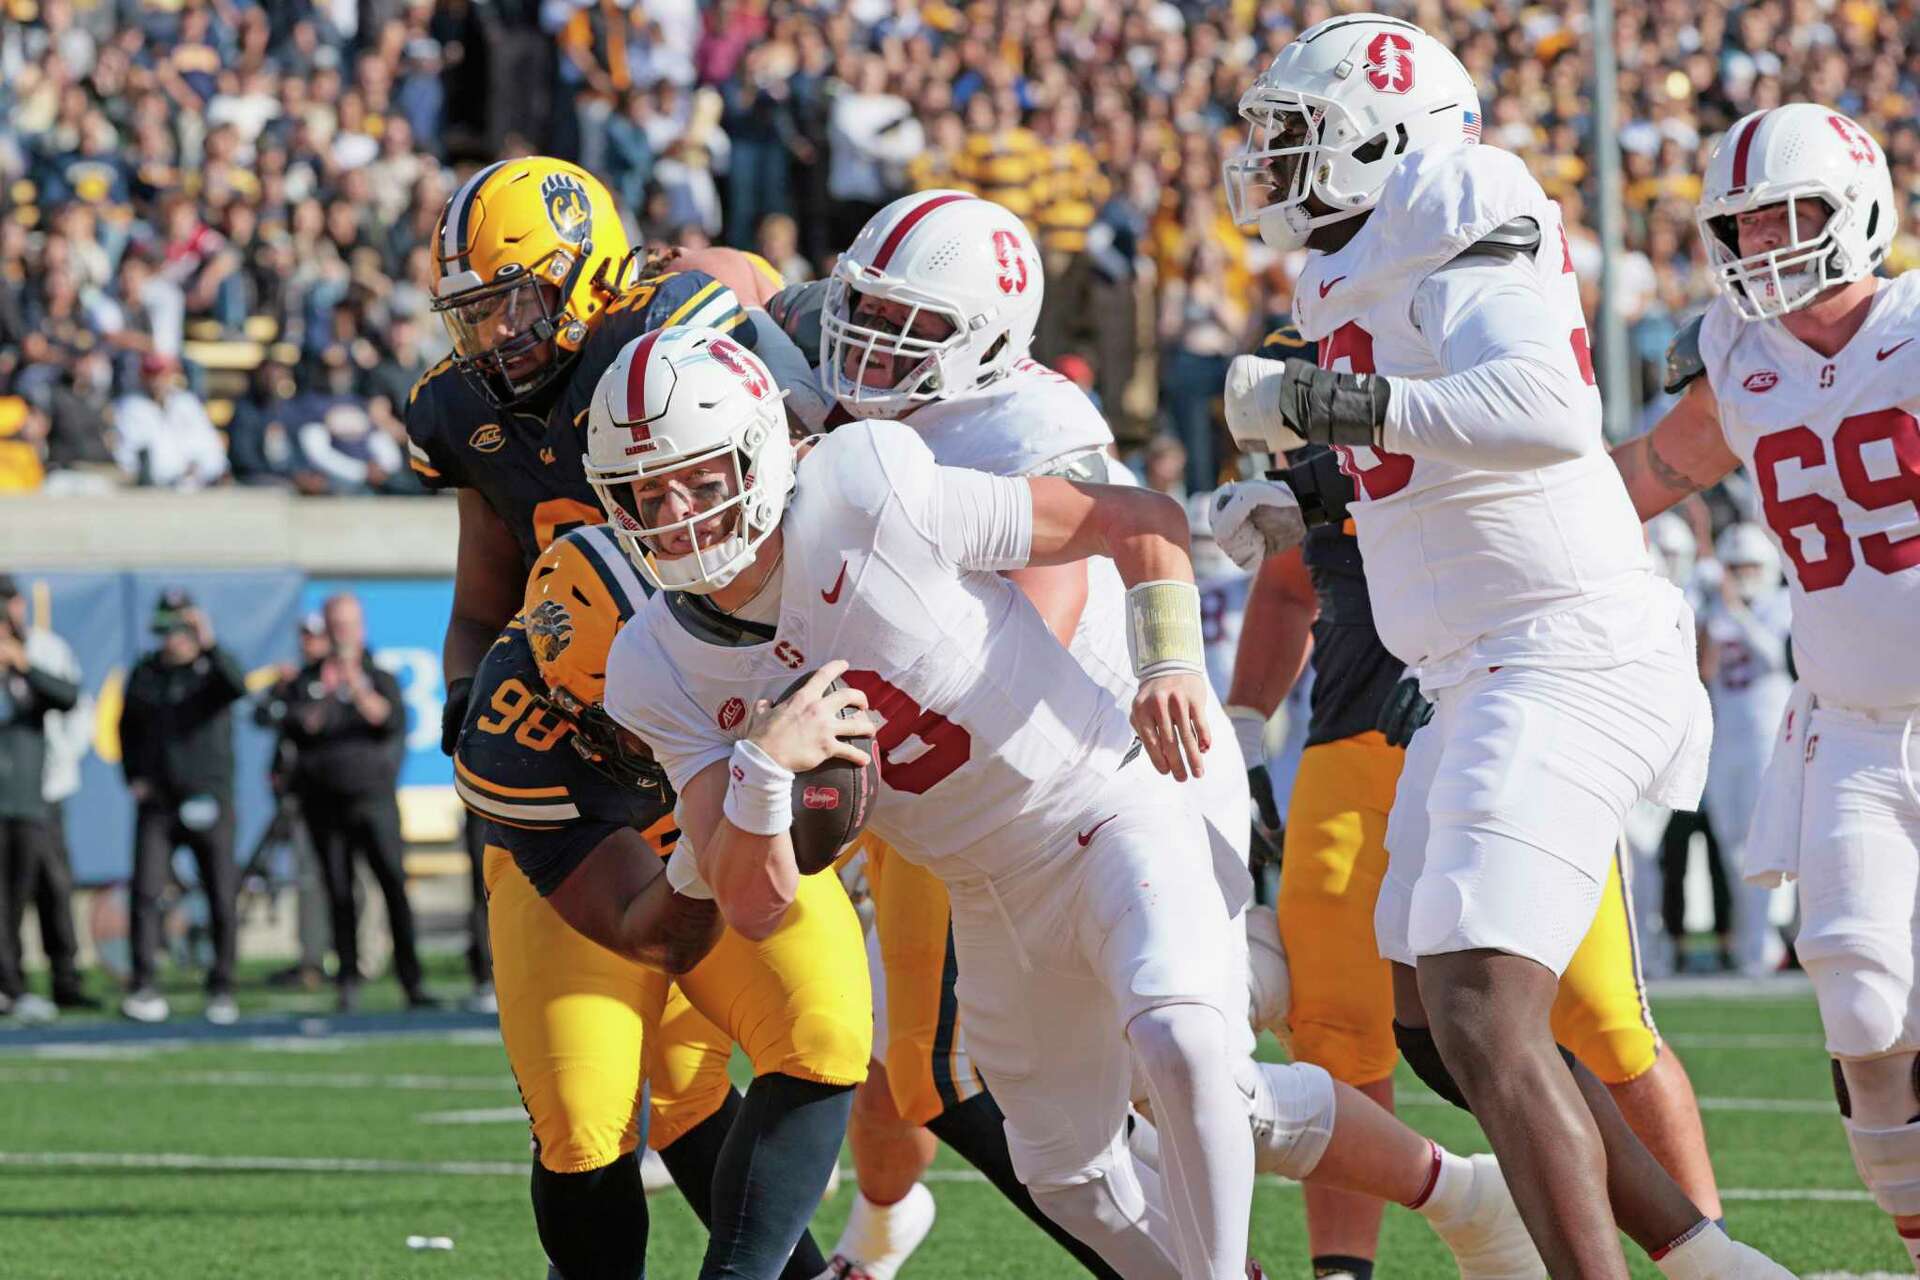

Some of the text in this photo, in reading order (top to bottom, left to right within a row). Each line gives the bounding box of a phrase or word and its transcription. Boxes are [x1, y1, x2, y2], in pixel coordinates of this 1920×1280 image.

[1367, 31, 1415, 95] S
[552, 191, 588, 231] Cal
[992, 230, 1028, 294] S
[707, 338, 769, 401] S
[1819, 363, 1836, 389] S
[475, 428, 503, 448] ACC
[1754, 407, 1920, 592] 69
[774, 640, 804, 669] S
[477, 678, 567, 752] 98
[719, 698, 745, 731] ACC
[803, 786, 840, 809] S
